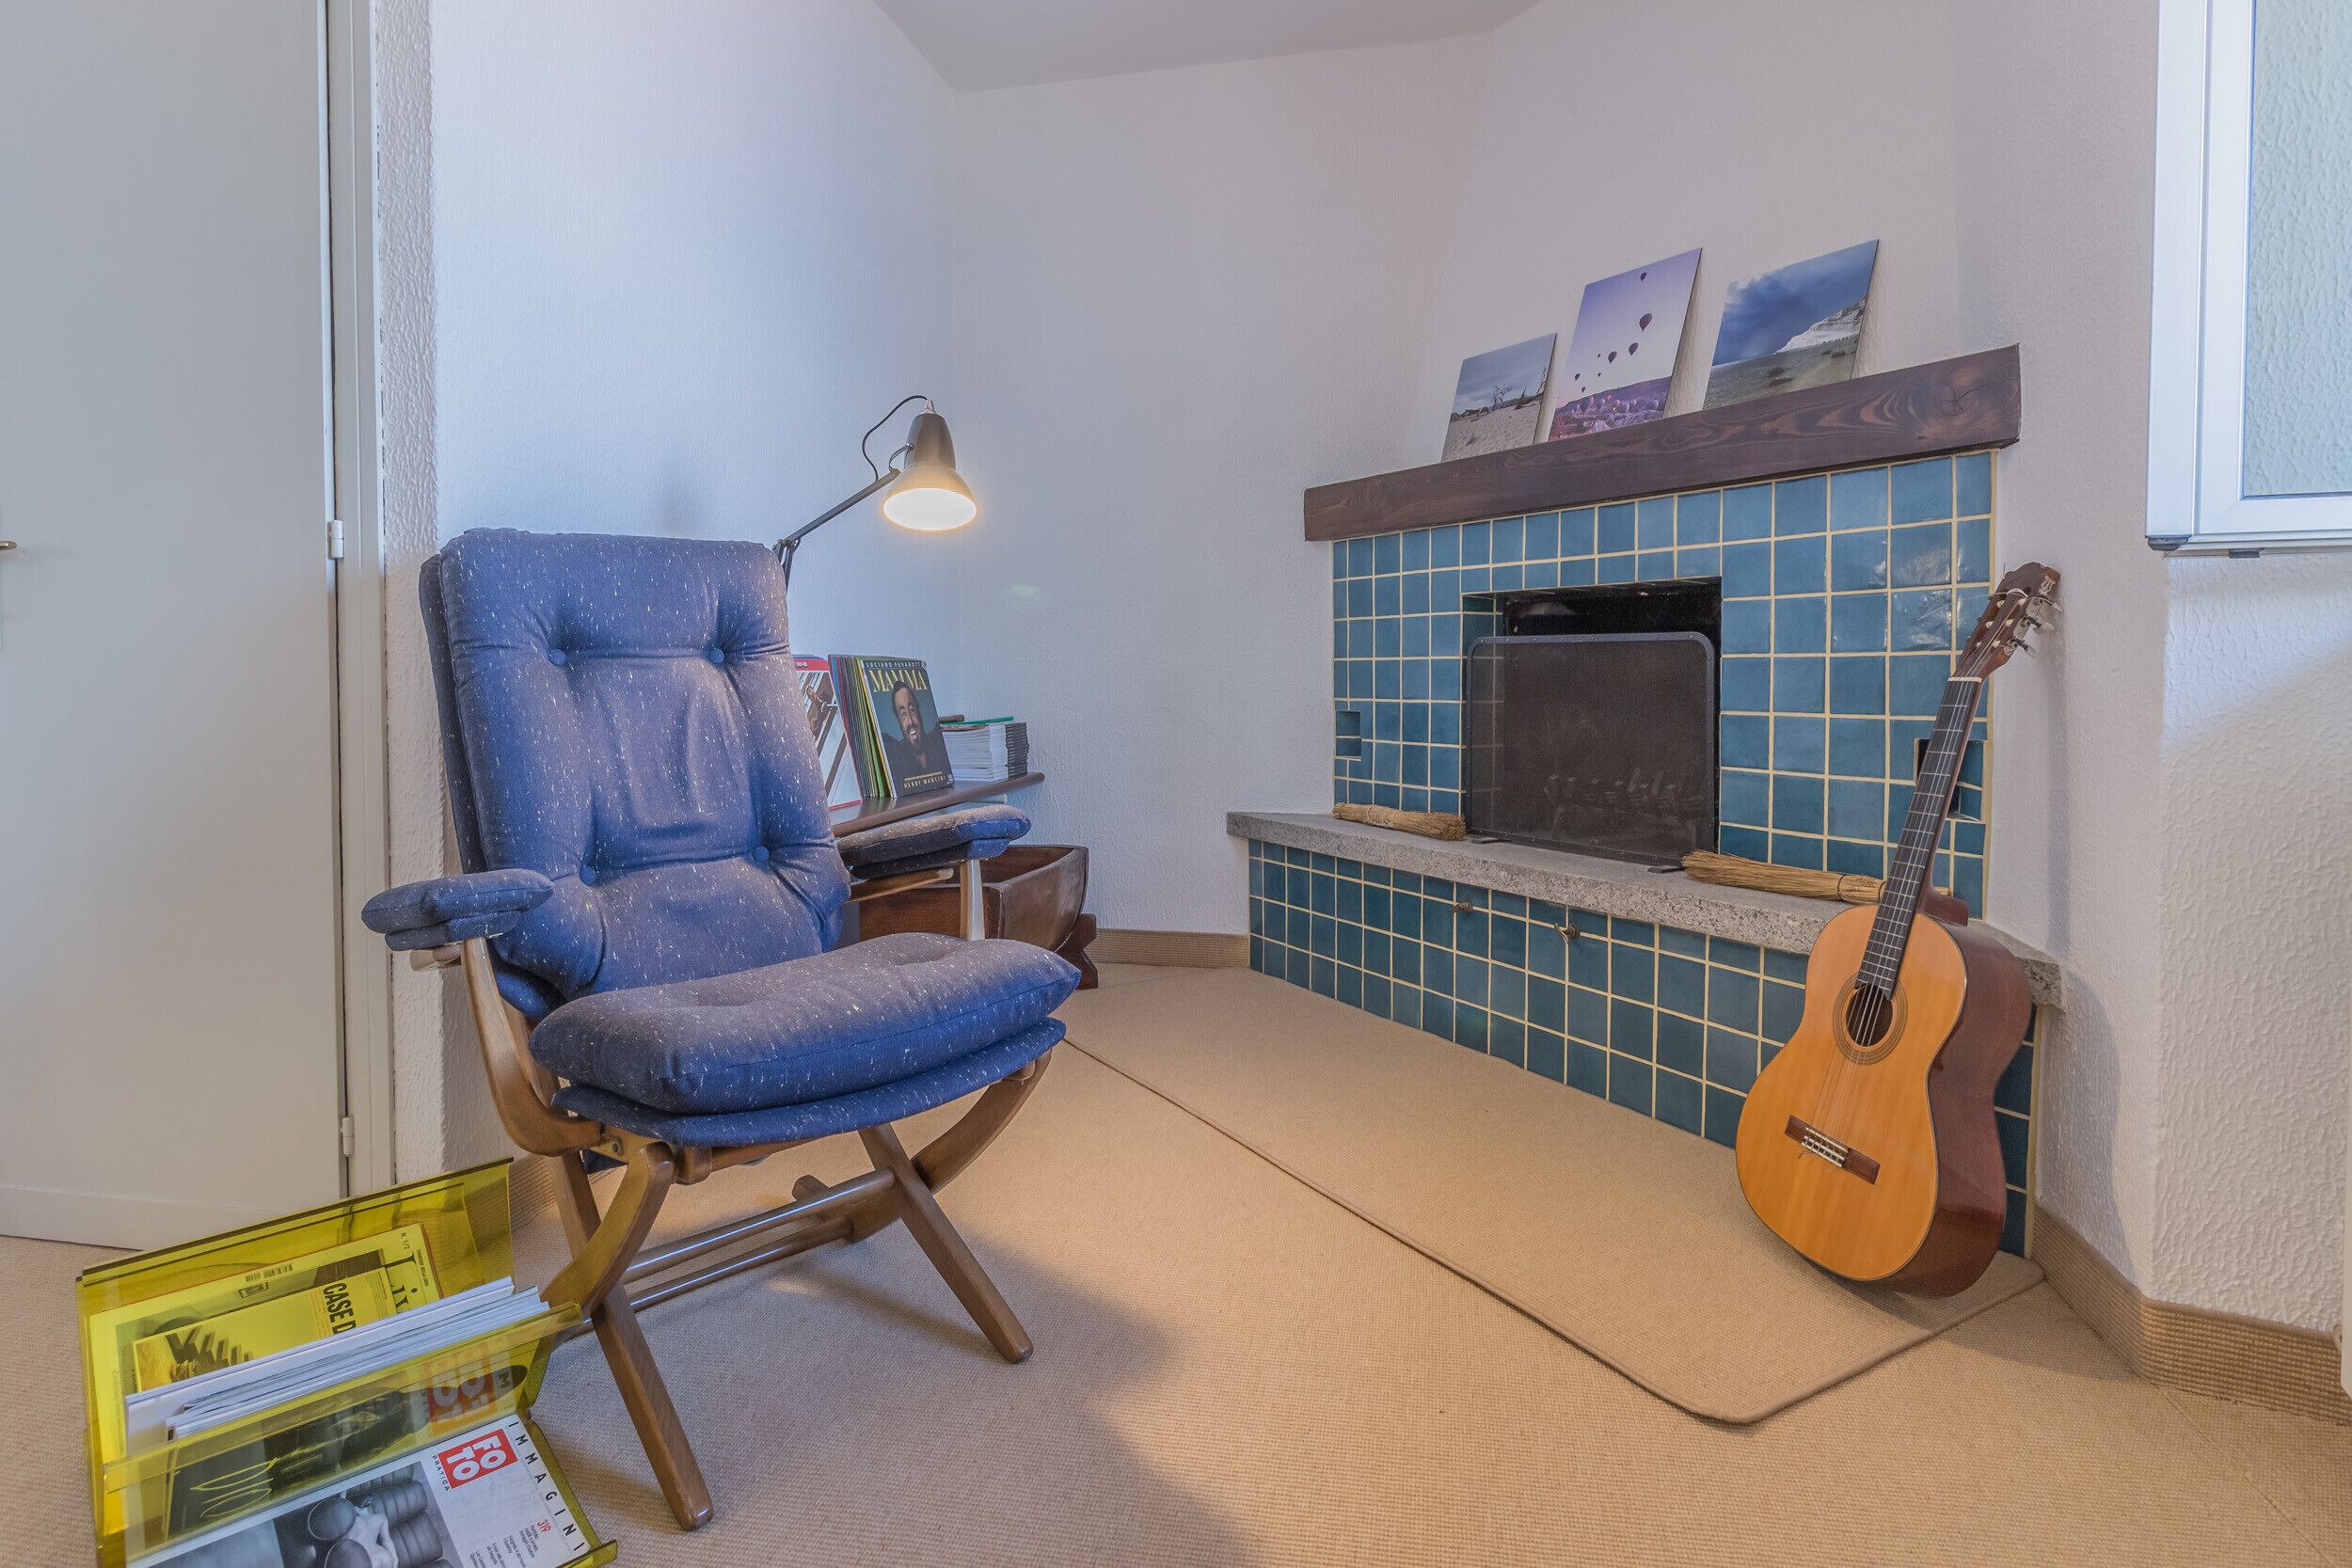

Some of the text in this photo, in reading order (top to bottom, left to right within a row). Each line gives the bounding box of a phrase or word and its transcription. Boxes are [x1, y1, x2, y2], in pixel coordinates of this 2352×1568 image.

[868, 669, 928, 692] MAMMA
[323, 1282, 355, 1323] CASE
[432, 1453, 450, 1492] PRATICA
[508, 1421, 585, 1552] IMMAGINI
[536, 1518, 552, 1533] 319
